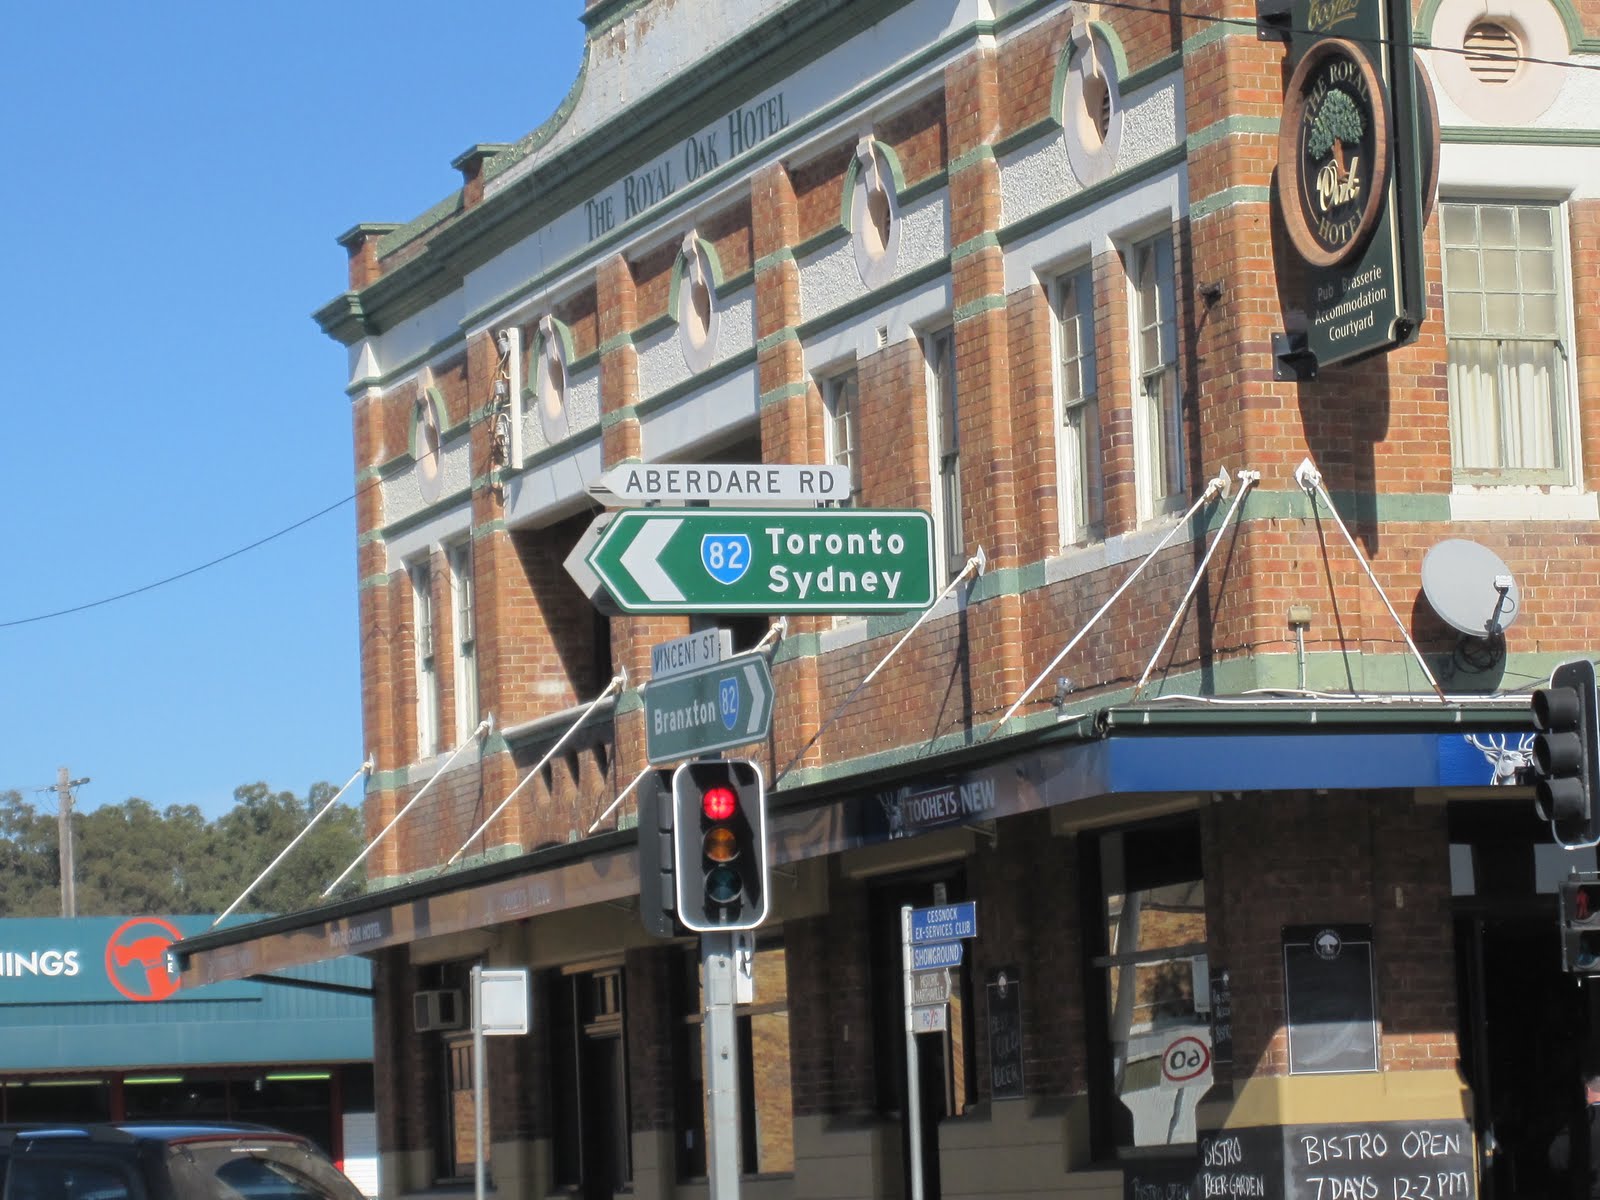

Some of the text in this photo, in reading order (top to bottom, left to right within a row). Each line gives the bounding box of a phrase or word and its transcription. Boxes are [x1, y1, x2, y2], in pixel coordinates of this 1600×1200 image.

[1303, 60, 1368, 125] THE ROYAL
[584, 92, 790, 242] THE ROYAL OAK HOTEL
[1317, 264, 1383, 301] Pub Brasserie
[1314, 287, 1388, 326] Accommodation
[1328, 310, 1375, 341] Courtyard
[625, 469, 835, 494] ABERDARE RD
[708, 541, 744, 570] 82
[764, 527, 905, 555] Toronto
[767, 565, 902, 599] Sydney
[653, 634, 715, 673] VINCENT ST
[654, 686, 737, 736] Branxton 82
[907, 778, 995, 823] TOOHEYS NEW
[915, 920, 972, 940] EX-SERVICES CLUB
[926, 907, 959, 924] CESSNOCK
[914, 944, 960, 967] SHOWGROUND
[1201, 1137, 1242, 1167] BISTRO
[1301, 1130, 1461, 1165] BISTRO OPEN
[1328, 1176, 1379, 1200] DAYS
